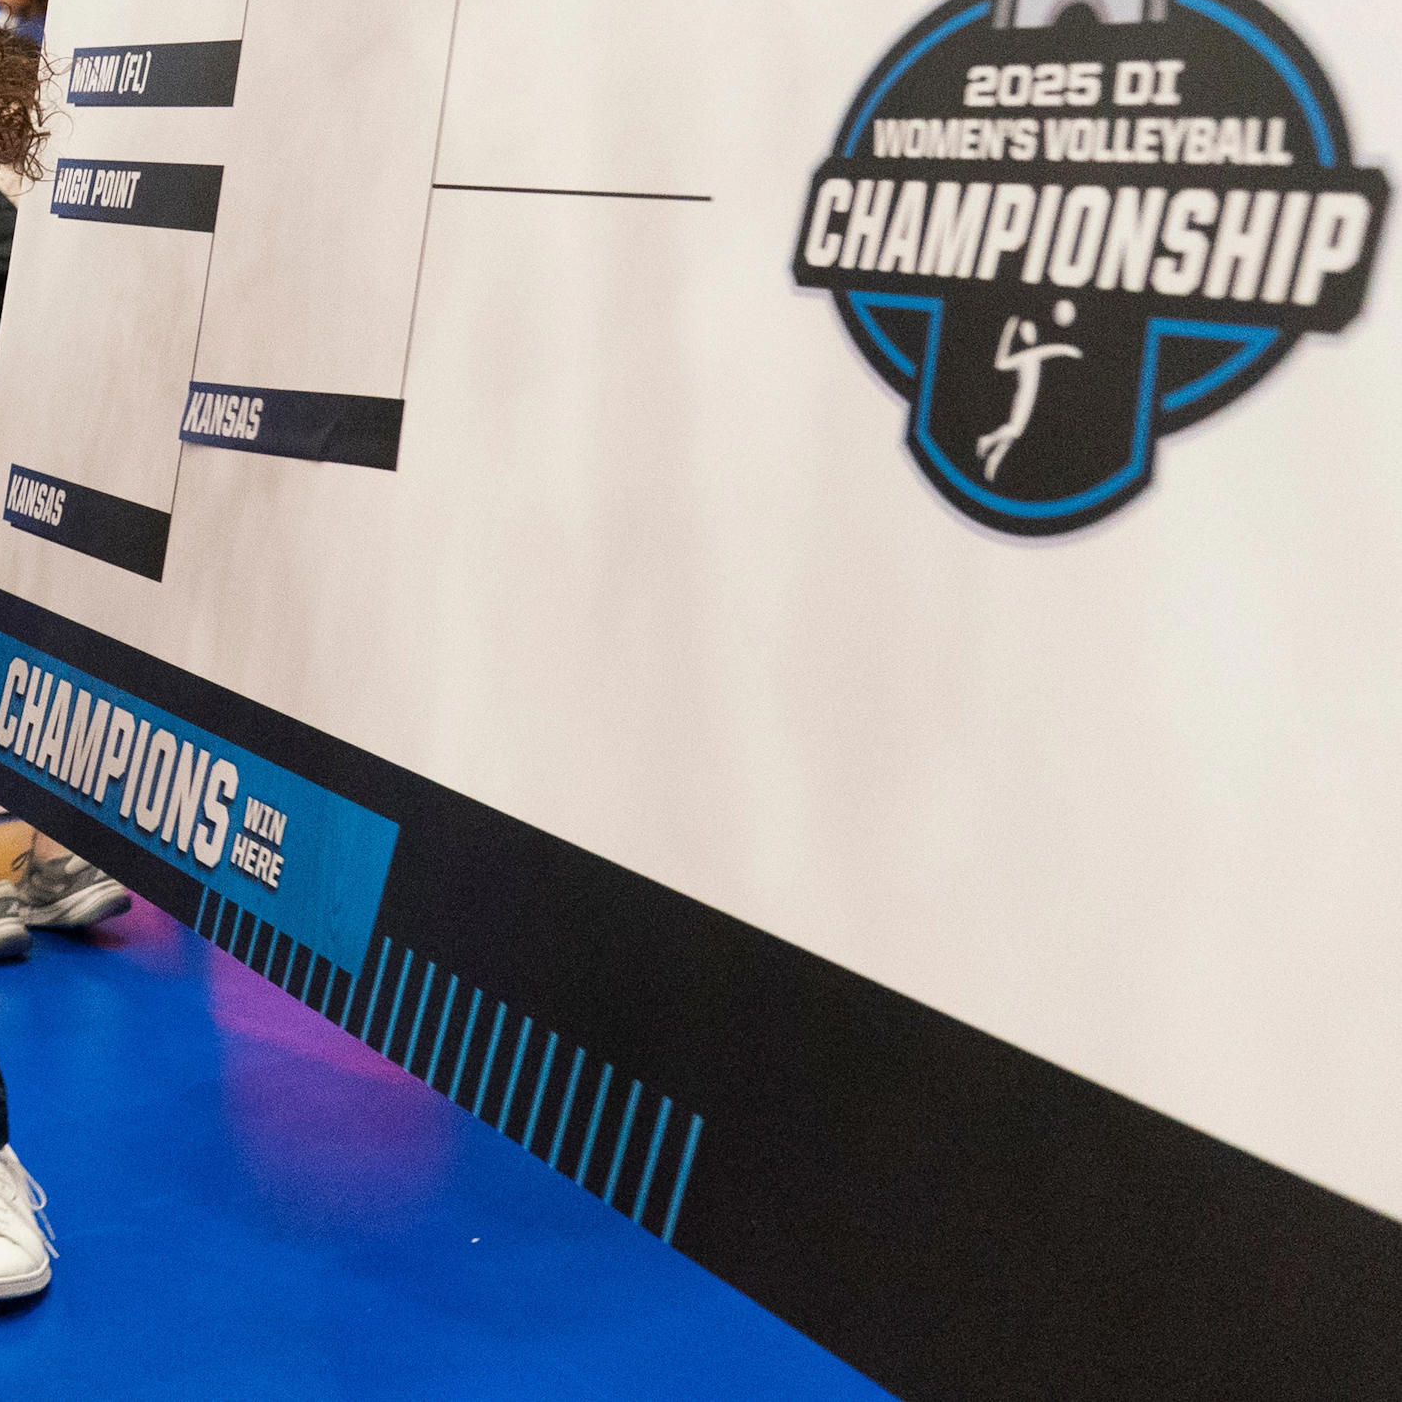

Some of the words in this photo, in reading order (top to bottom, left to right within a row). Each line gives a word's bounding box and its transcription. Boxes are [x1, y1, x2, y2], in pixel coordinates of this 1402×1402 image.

[69, 55, 121, 93] MIAMI
[118, 50, 152, 94] (FL)
[963, 62, 1102, 107] 2025
[1112, 59, 1186, 106] DI
[872, 118, 1038, 161] WOMEN'S
[1042, 117, 1293, 167] VOLLEYBALL
[53, 168, 94, 206] HIGH
[90, 169, 142, 209] POINT
[803, 177, 1373, 306] CHAMPIONSHIP
[182, 391, 263, 441] KANSAS
[6, 473, 66, 528] KANSAS
[243, 795, 288, 847] WIN
[229, 832, 285, 889] HERE
